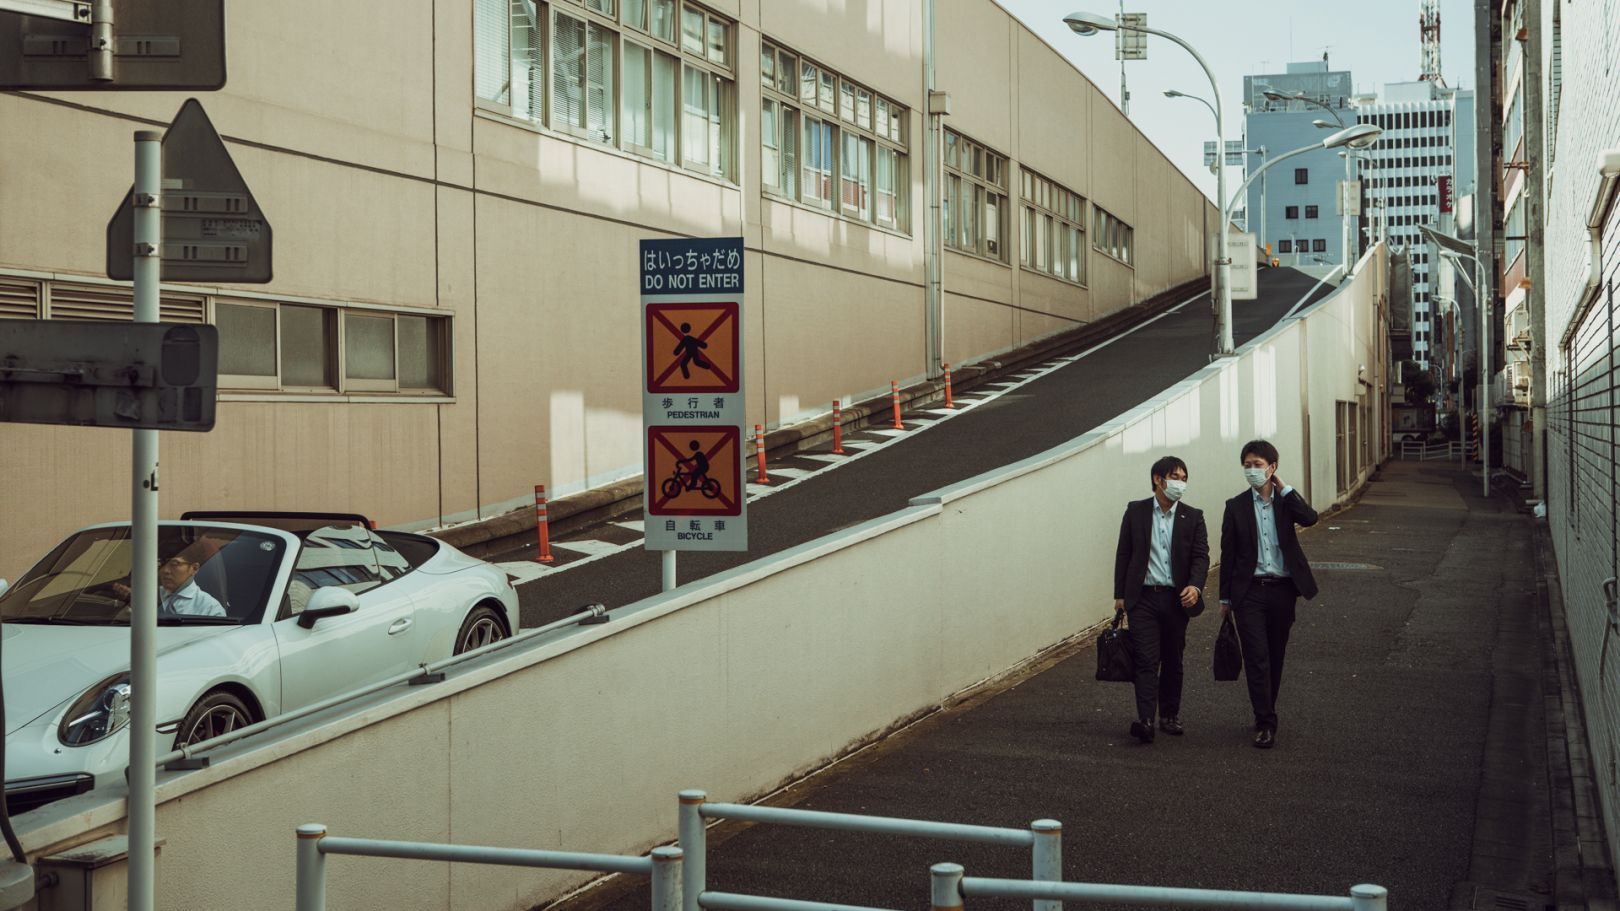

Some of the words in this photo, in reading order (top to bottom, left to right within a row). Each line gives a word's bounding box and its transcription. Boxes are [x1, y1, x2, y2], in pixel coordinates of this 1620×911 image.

[644, 248, 740, 271] はいっちゃだめ
[645, 274, 663, 289] DO
[668, 274, 694, 289] NOT
[699, 273, 739, 288] ENTER
[667, 411, 720, 419] PEDESTRIAN
[677, 532, 713, 540] BICYCLE
